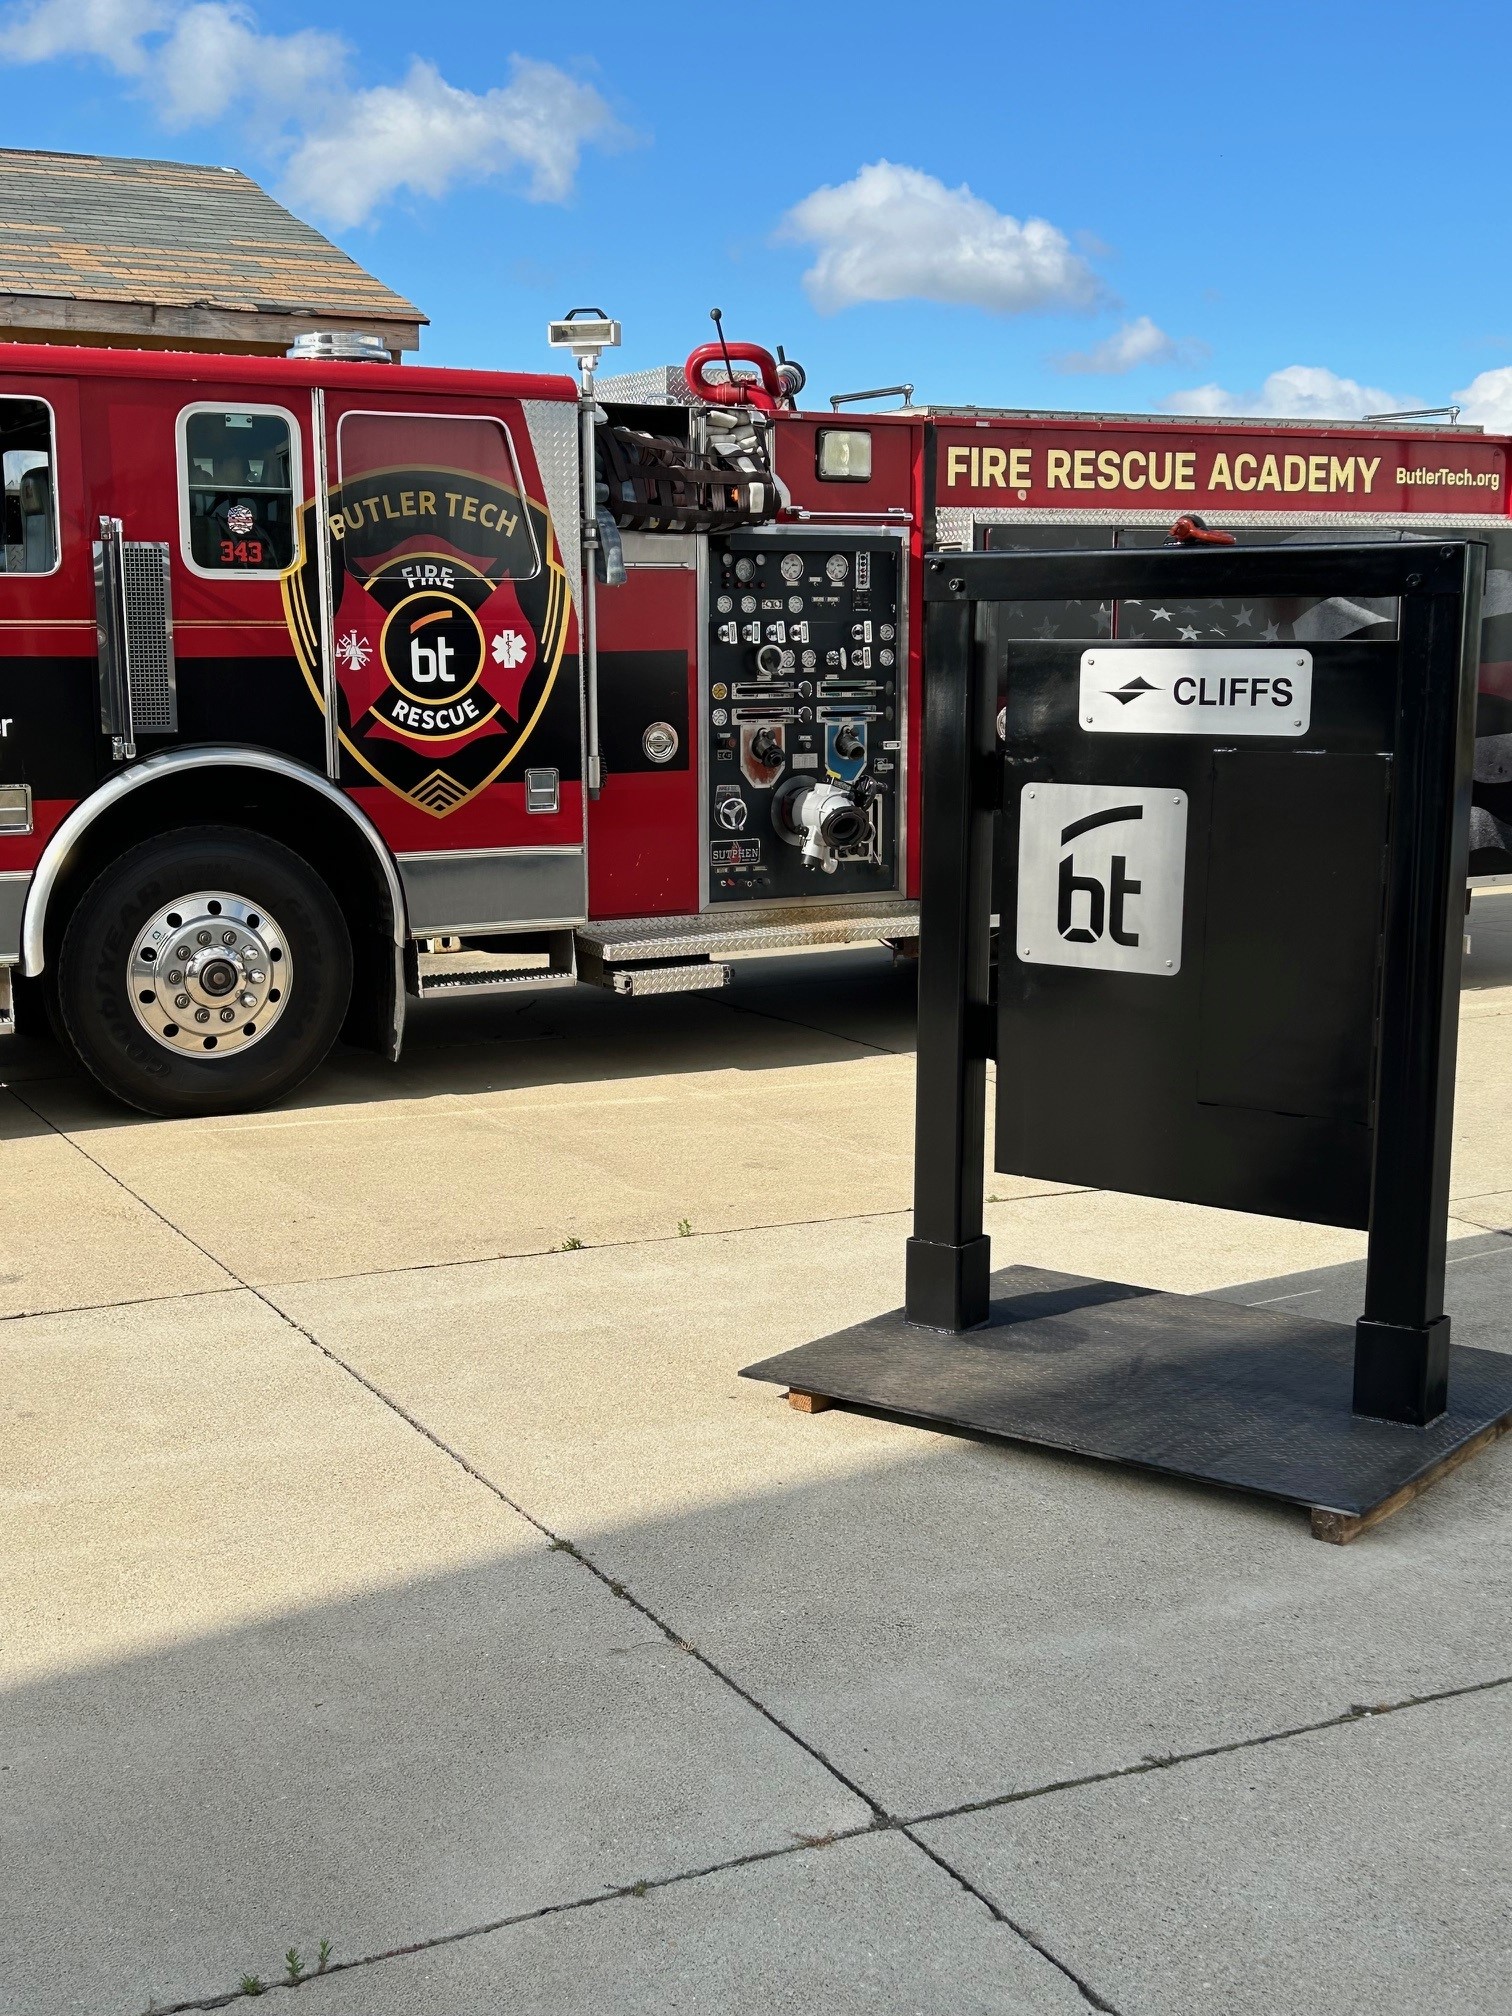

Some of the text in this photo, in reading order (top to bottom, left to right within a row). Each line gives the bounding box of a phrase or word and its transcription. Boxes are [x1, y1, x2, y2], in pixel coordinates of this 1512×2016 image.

[947, 446, 1382, 494] FIRE RESCUE ACADEMY
[1396, 467, 1500, 491] ButlerTech.org
[328, 490, 519, 541] BUTLER TECH
[220, 540, 263, 563] 343
[401, 564, 455, 589] FIRE
[410, 636, 456, 683] bt
[1173, 676, 1293, 707] CLIFFS
[391, 698, 480, 730] RESCUE
[712, 847, 759, 860] SUTPHEN
[1057, 852, 1142, 948] bt
